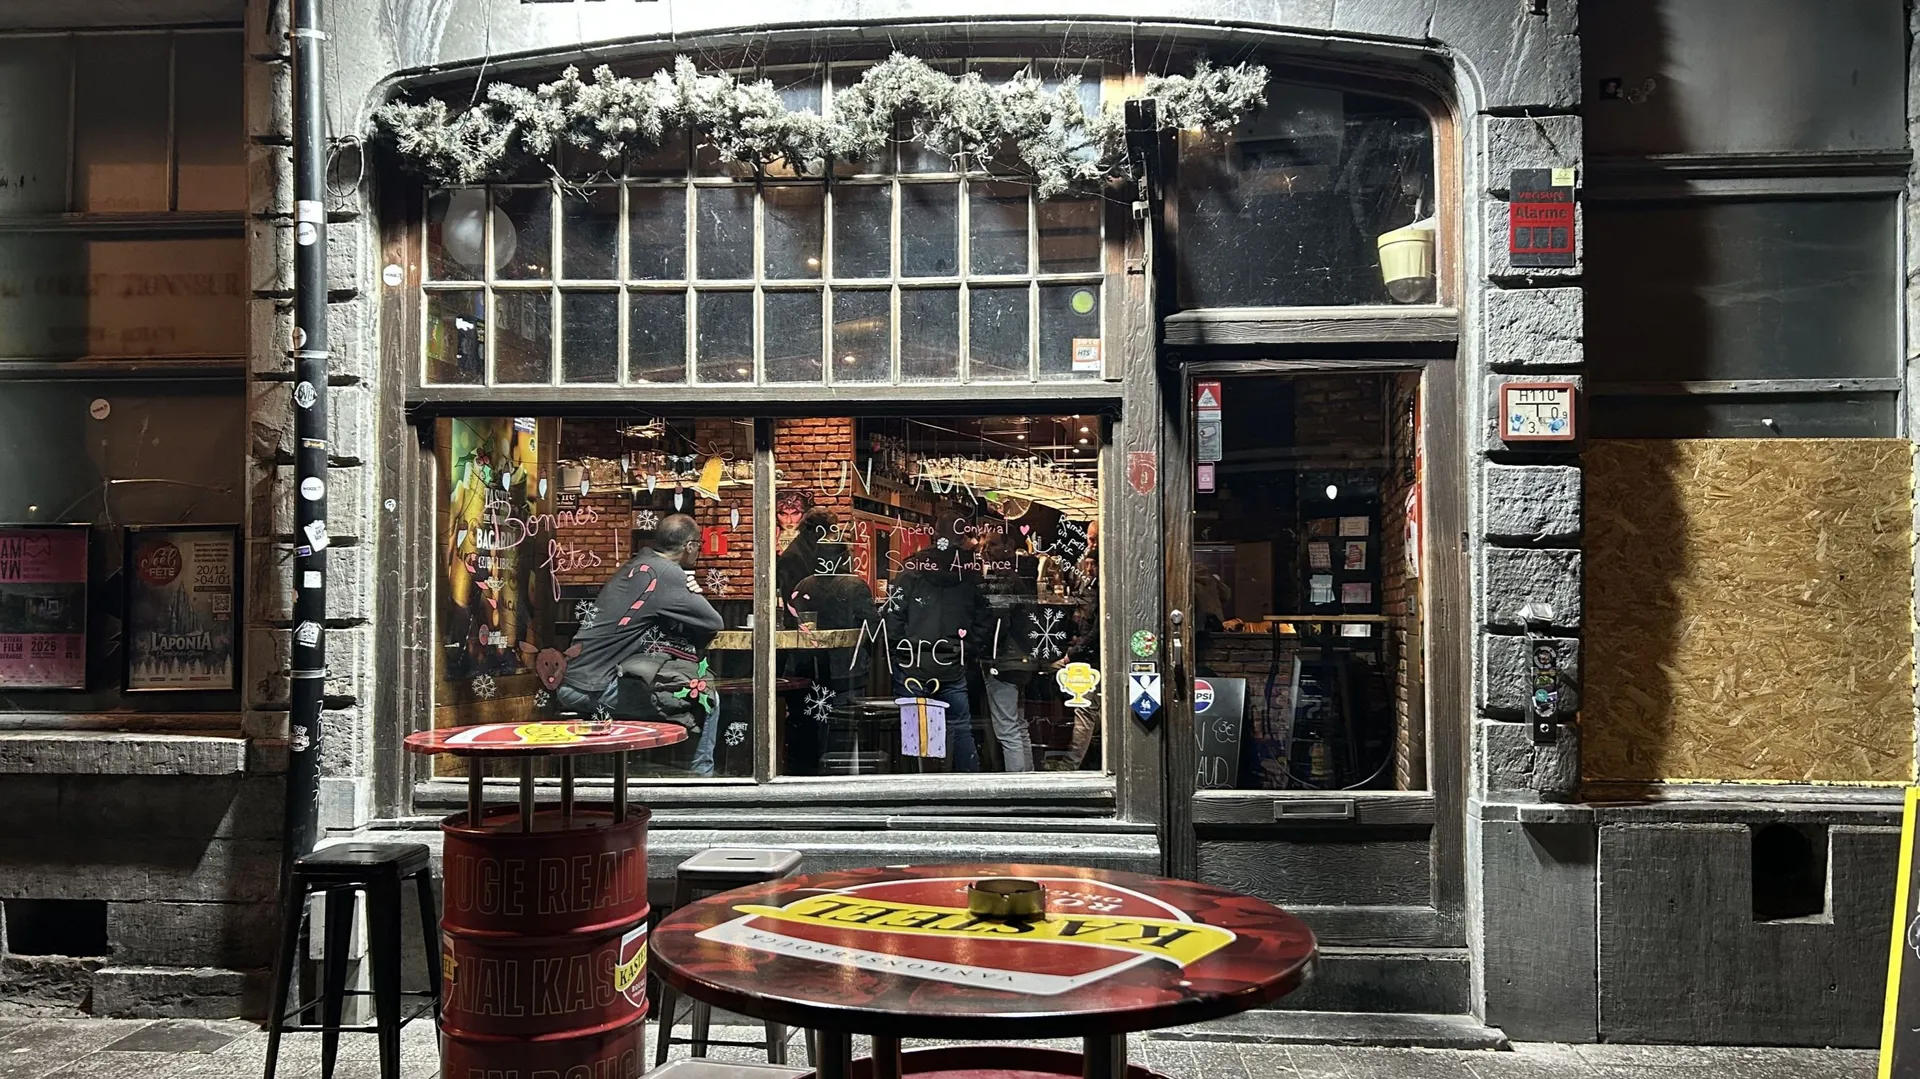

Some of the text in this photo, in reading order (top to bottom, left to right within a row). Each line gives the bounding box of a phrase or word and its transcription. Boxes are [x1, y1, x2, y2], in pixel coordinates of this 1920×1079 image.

[1516, 206, 1568, 219] Alarme
[819, 457, 872, 497] UN
[485, 500, 598, 550] Bonnes
[815, 514, 1009, 551] 29/12 Apéro Convivial
[140, 547, 177, 569] Noël
[1056, 538, 1074, 556] truc
[149, 566, 175, 577] FÊTE
[196, 564, 227, 575] 20/12
[540, 538, 602, 603] fêtes
[814, 556, 862, 574] 30/12
[885, 550, 940, 578] Soirée
[3, 643, 23, 652] FILM
[31, 641, 57, 651] 2026
[849, 617, 1001, 675] Merci !
[814, 899, 1203, 950] KASTEEL
[745, 934, 1013, 983] VANHONSEBROUCK
